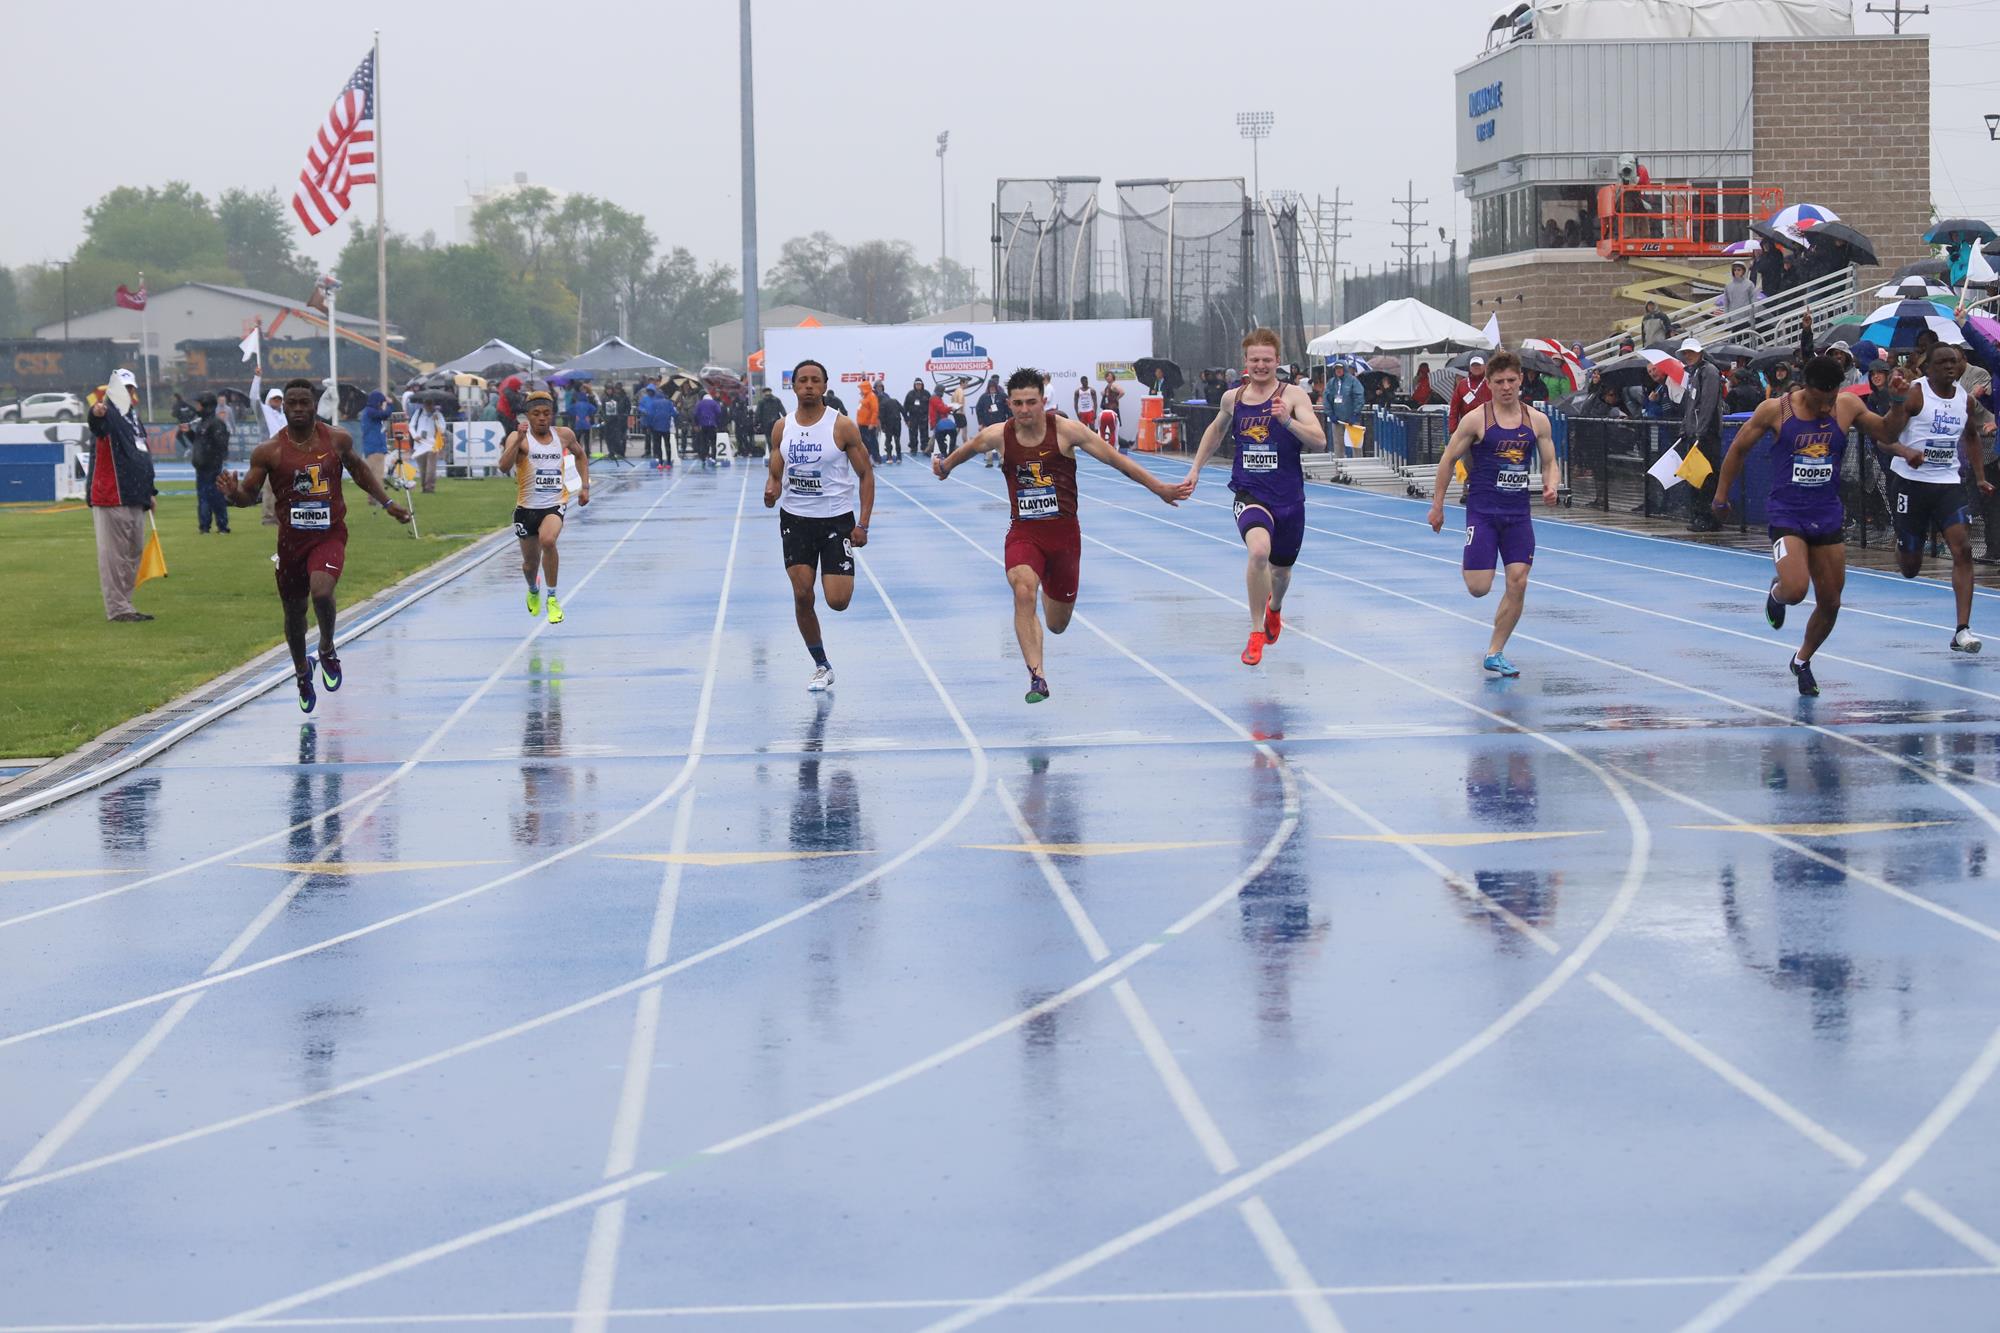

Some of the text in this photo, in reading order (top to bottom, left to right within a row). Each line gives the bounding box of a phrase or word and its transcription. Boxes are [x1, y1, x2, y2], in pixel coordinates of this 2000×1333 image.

[1641, 243, 1660, 251] JLG
[945, 338, 972, 352] VALLEY
[15, 352, 64, 375] CSX
[269, 348, 312, 370] CSX
[928, 362, 991, 371] CHAMPIONSHIPS
[1934, 409, 1961, 425] Indiana
[1930, 422, 1955, 436] State
[717, 442, 727, 456] 2
[788, 439, 822, 453] Indiana
[788, 452, 815, 464] State
[1243, 454, 1277, 464] TURCOTTE
[1498, 472, 1529, 484] BLOCKER
[1794, 467, 1832, 479] COOPER
[535, 477, 555, 485] CLARK
[788, 477, 822, 489] MITCHELL
[1019, 497, 1057, 510] CLAYTON
[292, 511, 328, 520] CHINDA
[1774, 541, 1782, 560] 7
